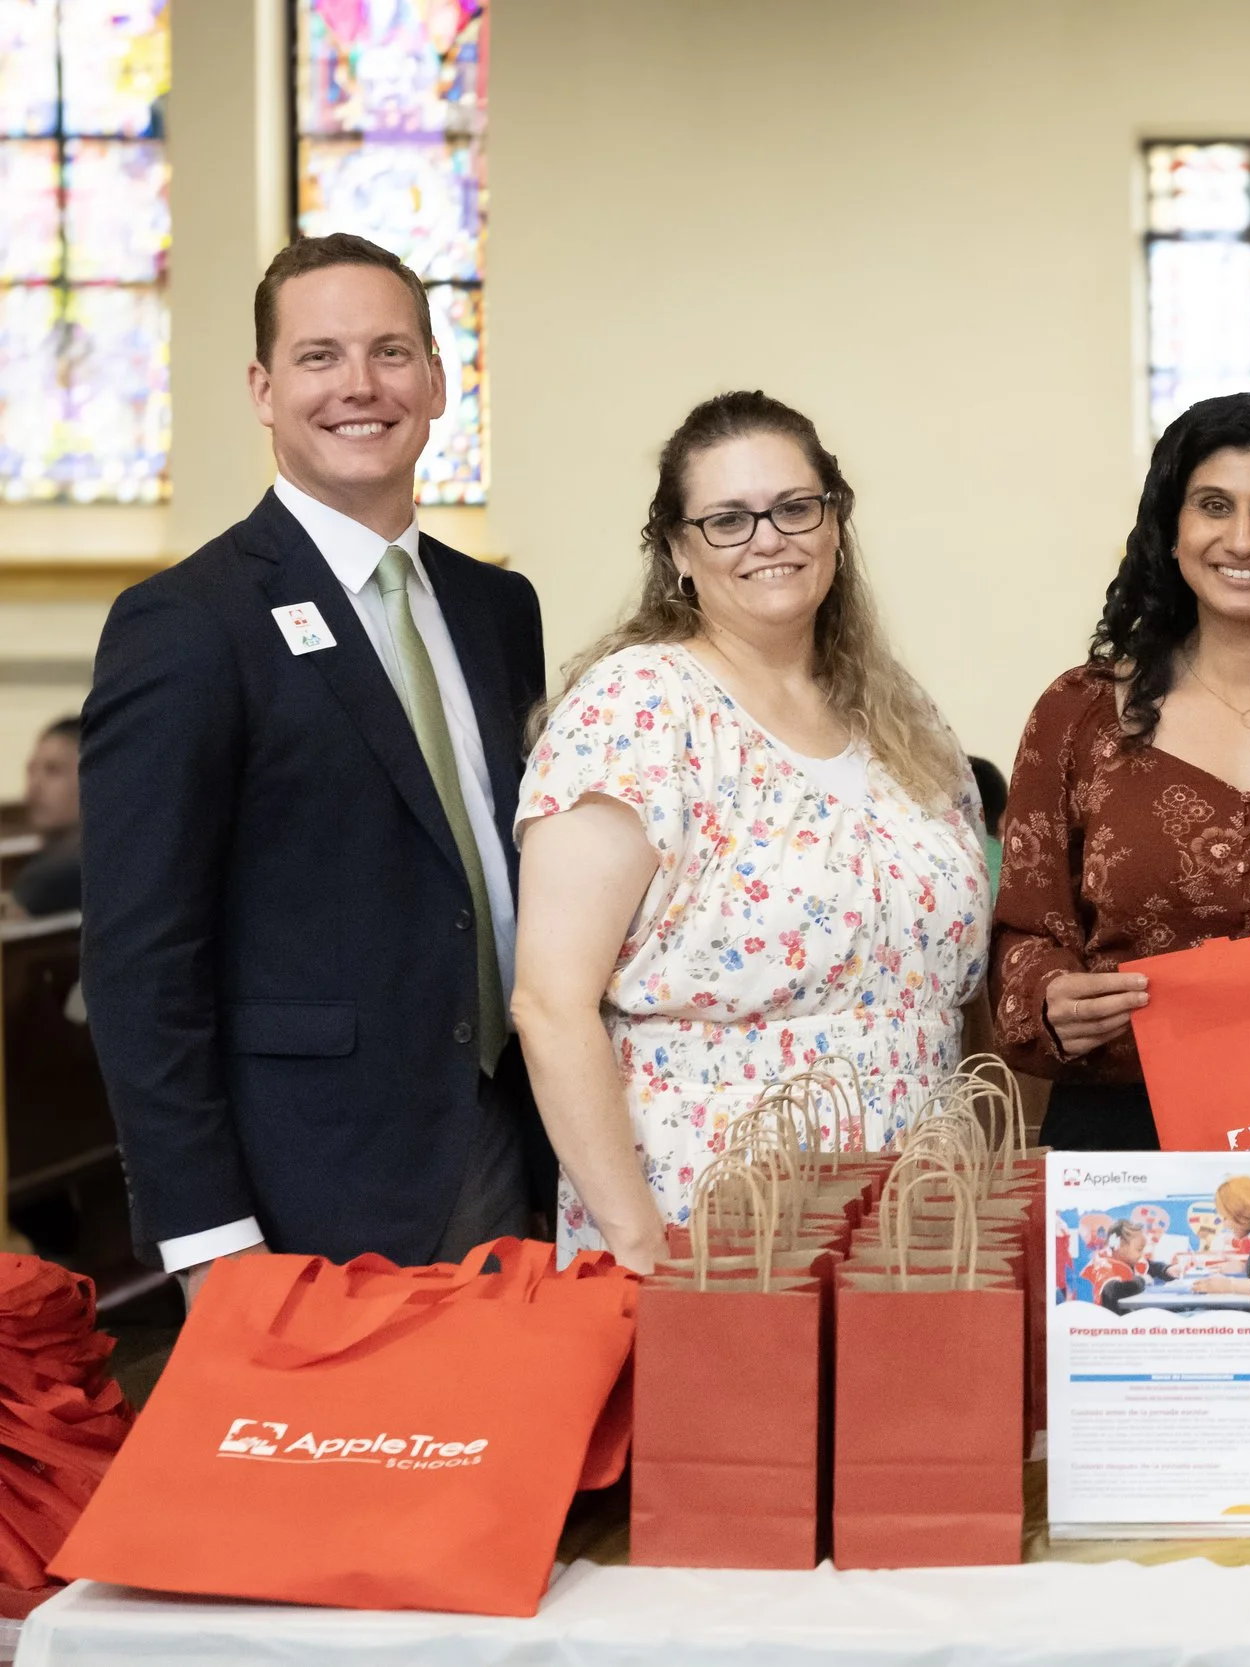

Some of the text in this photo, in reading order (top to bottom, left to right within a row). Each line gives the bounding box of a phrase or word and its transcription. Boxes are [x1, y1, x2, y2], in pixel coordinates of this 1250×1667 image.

[1083, 1171, 1148, 1186] AppleTree
[1069, 1327, 1128, 1337] Programa
[1131, 1327, 1146, 1335] de
[1170, 1326, 1234, 1335] extendido
[283, 1431, 489, 1460] AppleTree
[384, 1455, 483, 1470] SCHOOLS
